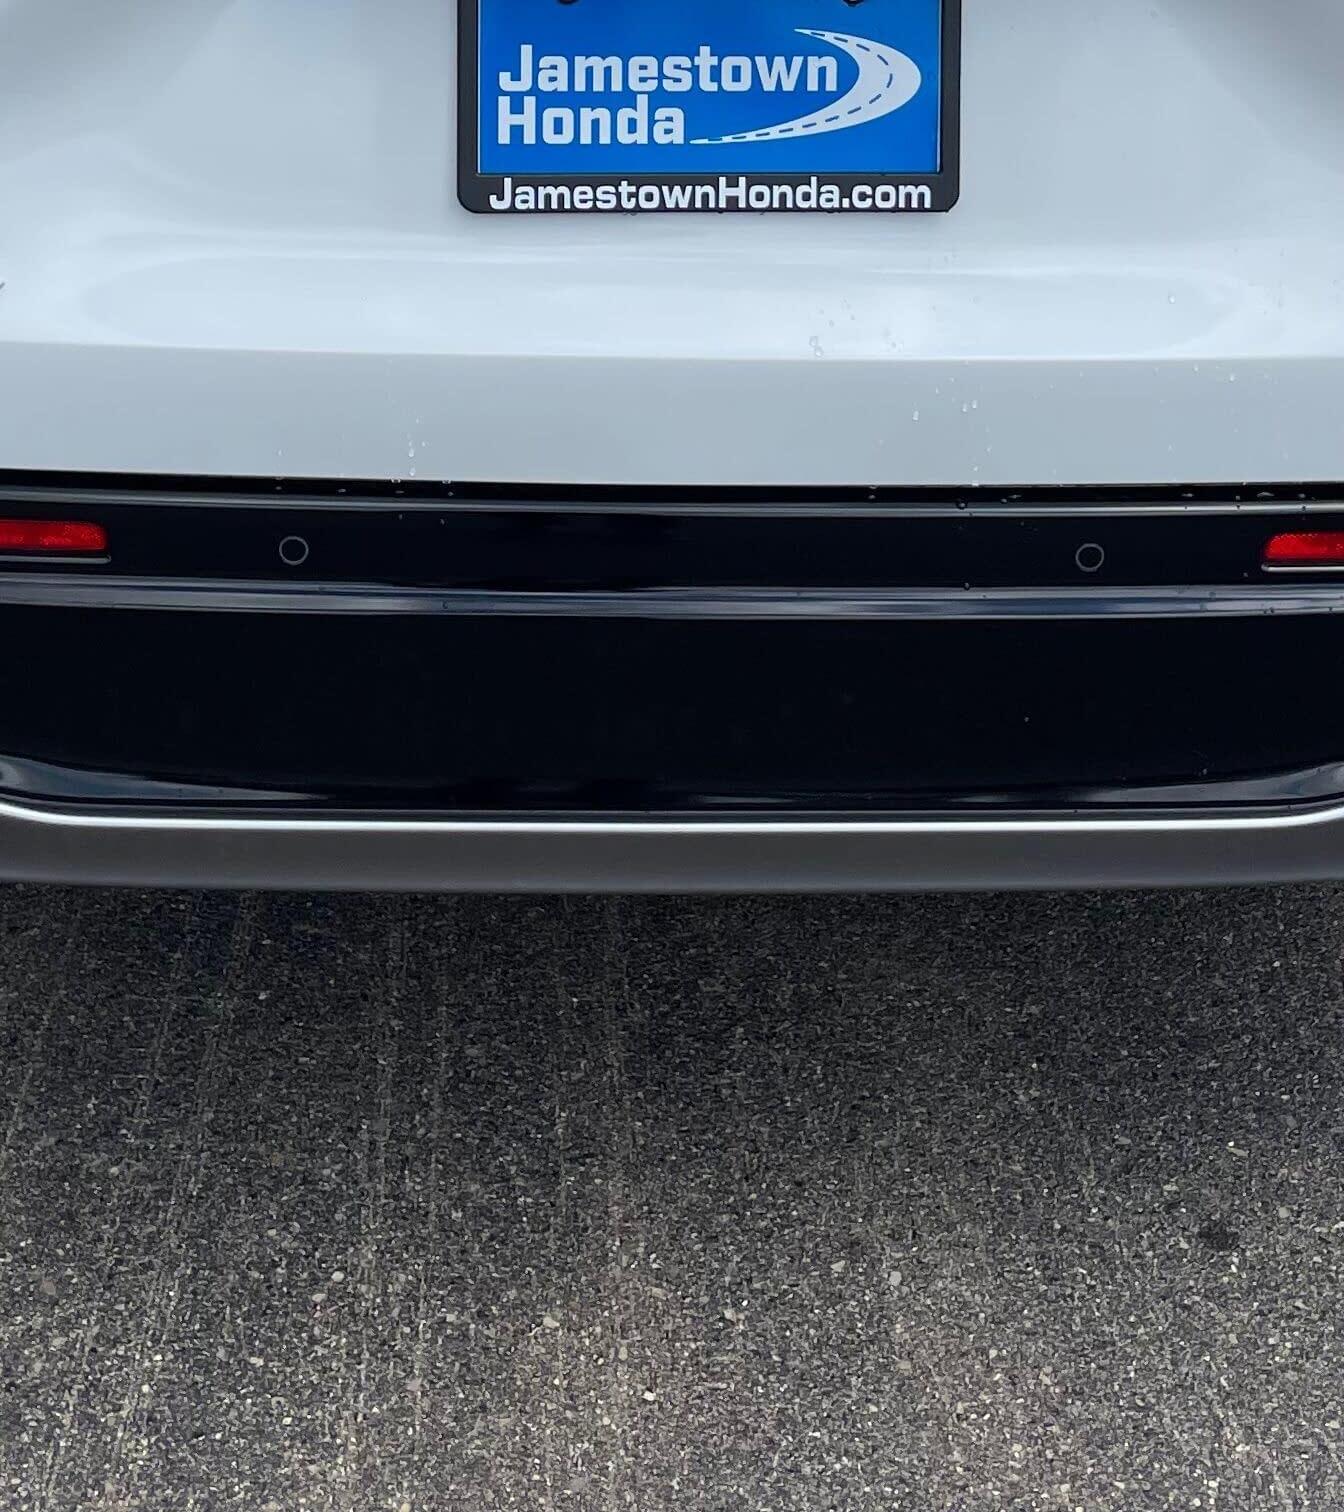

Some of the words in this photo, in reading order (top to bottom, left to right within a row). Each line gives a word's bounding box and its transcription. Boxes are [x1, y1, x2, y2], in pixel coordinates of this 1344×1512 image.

[498, 44, 838, 93] Jamestown
[497, 94, 685, 145] Honda
[489, 176, 932, 210] JamestownHonda.com
